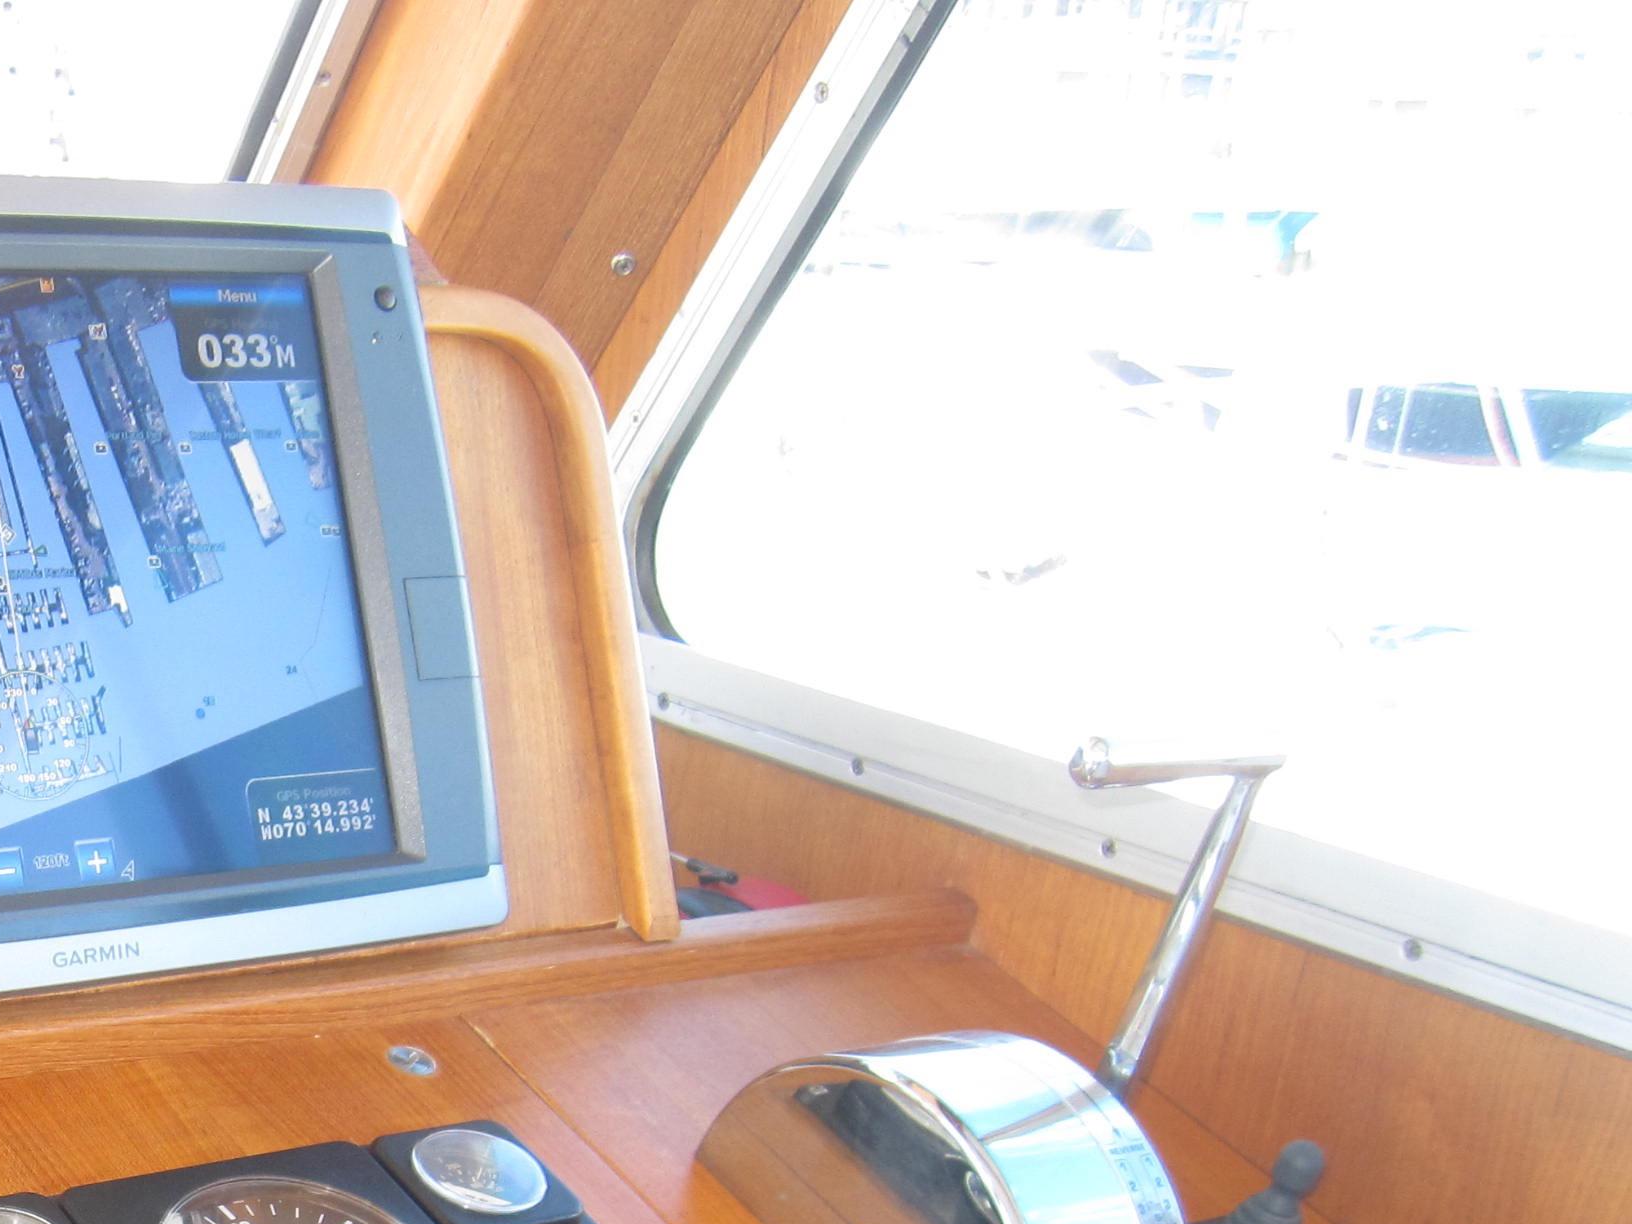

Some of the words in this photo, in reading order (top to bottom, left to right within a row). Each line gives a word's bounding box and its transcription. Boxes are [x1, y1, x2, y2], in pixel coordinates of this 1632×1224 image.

[217, 288, 257, 302] Menu
[276, 790, 301, 801] GPS
[257, 807, 271, 824] N
[51, 942, 141, 968] GARMIN
